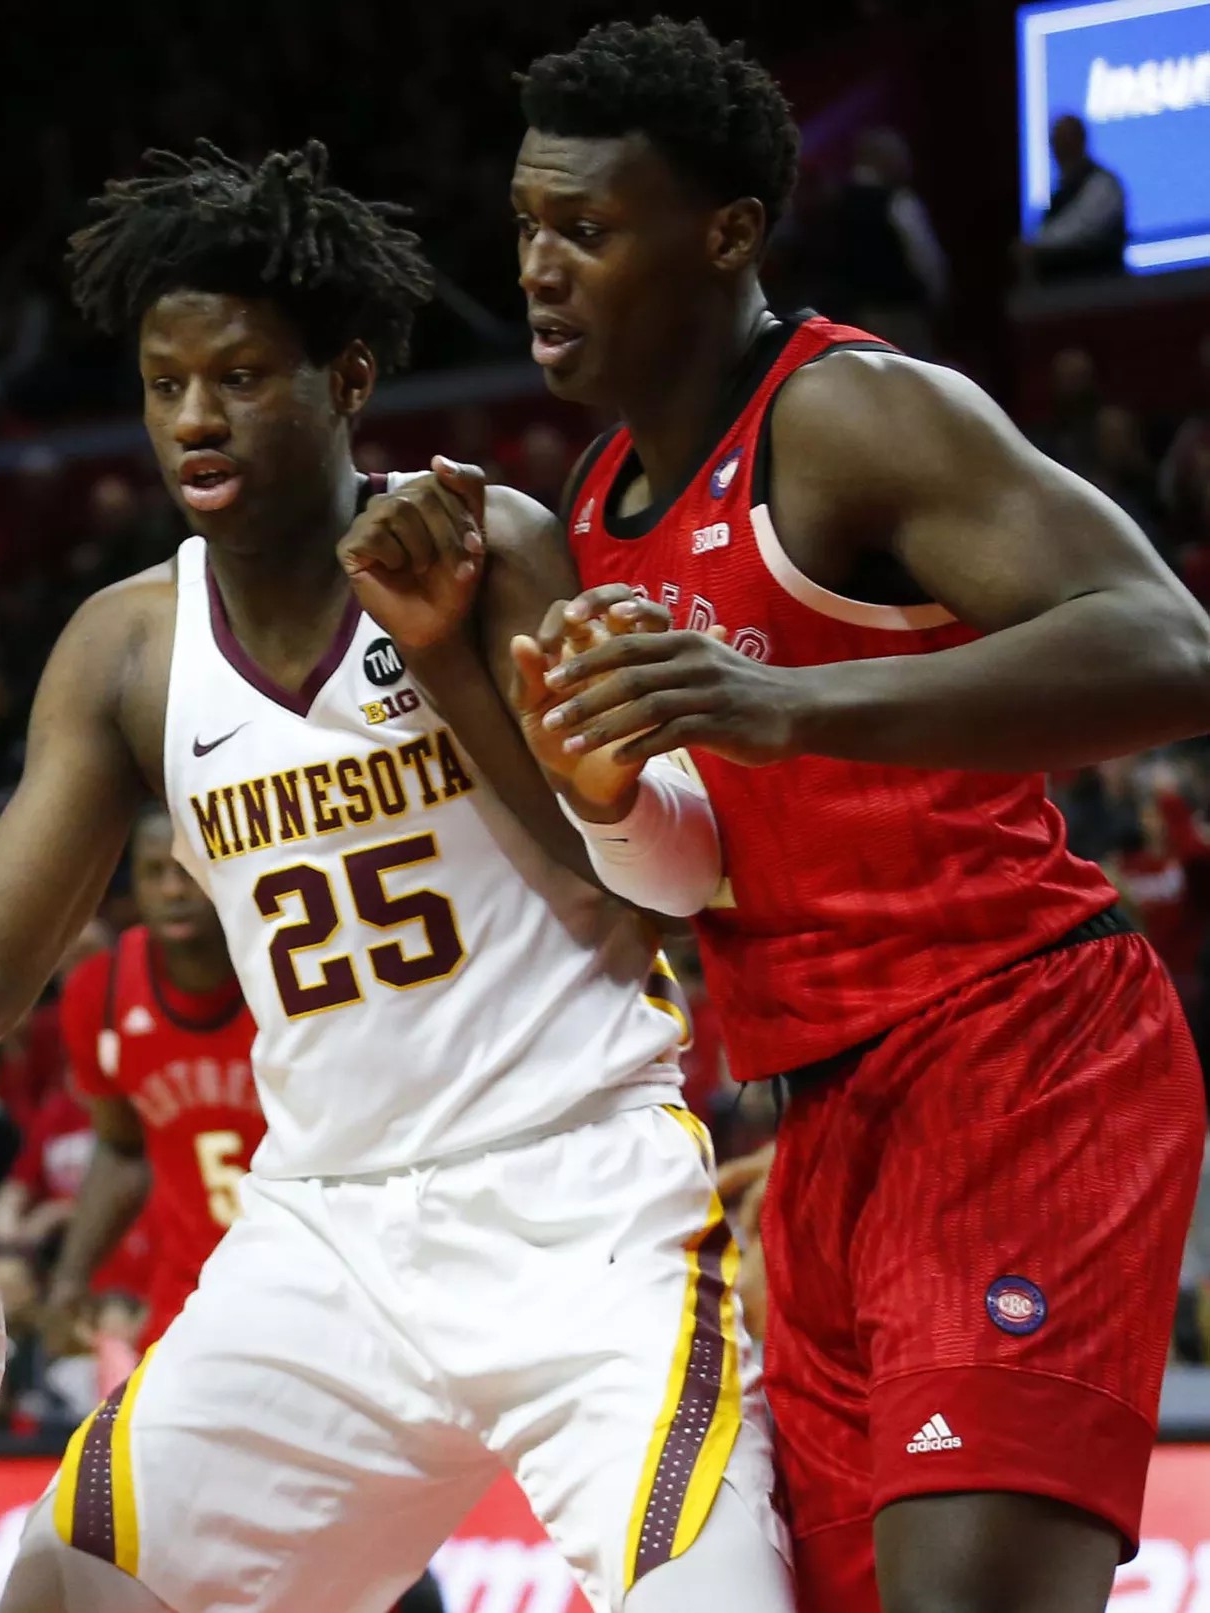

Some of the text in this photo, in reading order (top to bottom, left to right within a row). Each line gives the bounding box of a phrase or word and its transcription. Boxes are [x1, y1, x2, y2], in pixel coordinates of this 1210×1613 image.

[365, 645, 403, 678] TM
[190, 727, 475, 861] MINNESOTA
[252, 830, 467, 1020] 25
[193, 1131, 250, 1229] 5
[906, 1436, 962, 1453] adidas
